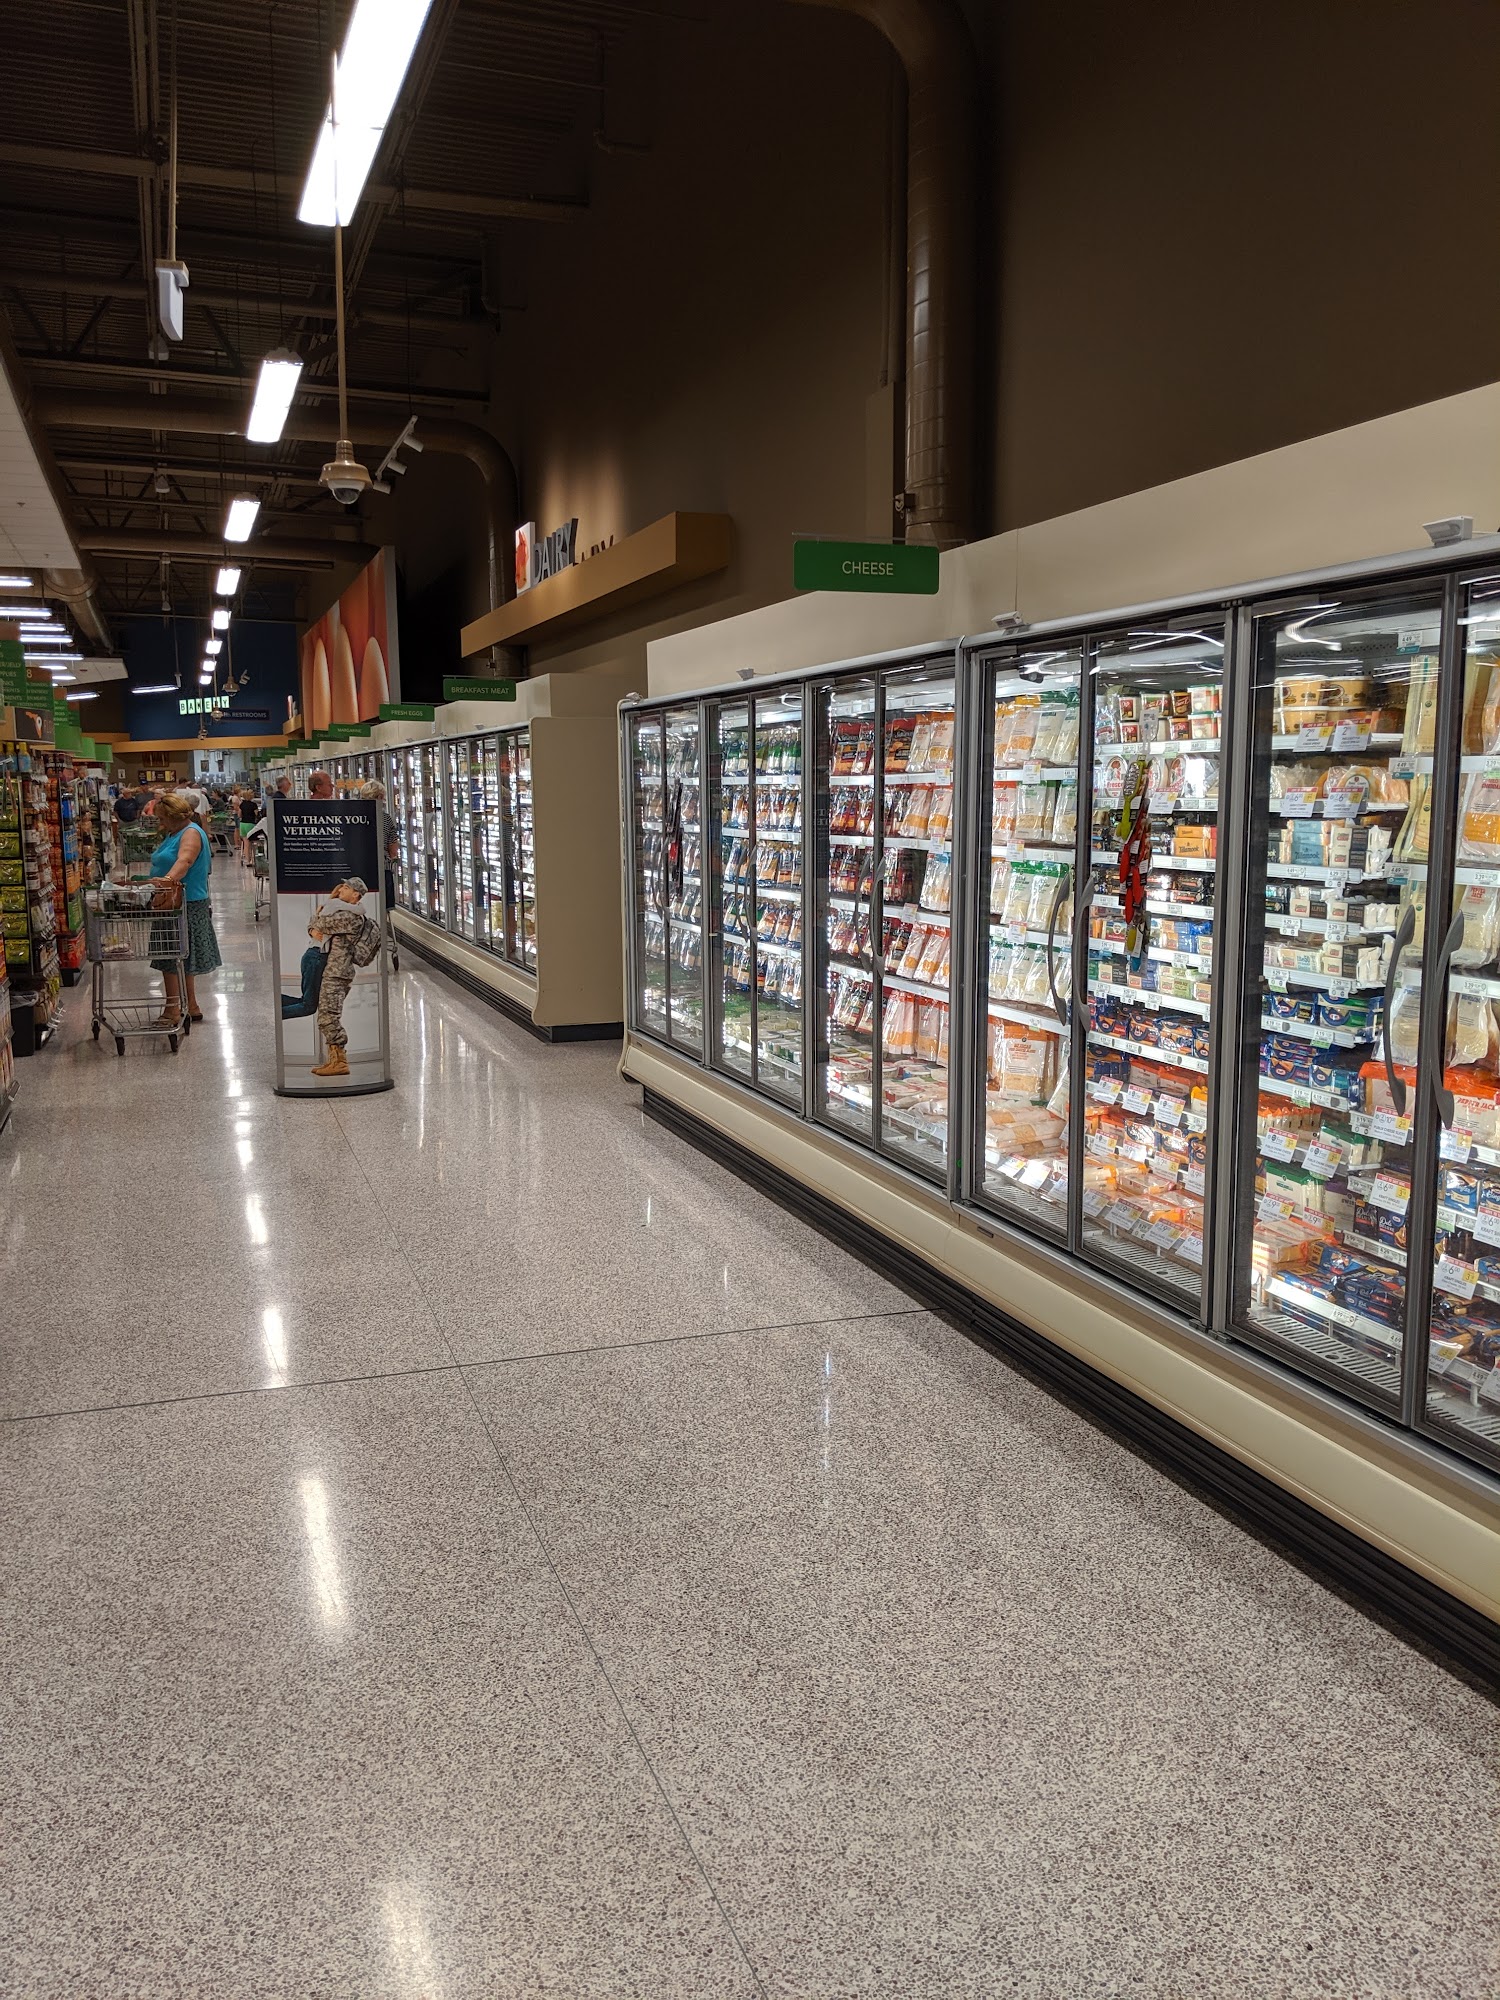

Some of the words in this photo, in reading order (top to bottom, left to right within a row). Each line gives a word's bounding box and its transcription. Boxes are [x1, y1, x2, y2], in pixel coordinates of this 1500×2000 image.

[533, 518, 578, 587] DAIRY
[842, 560, 894, 576] CHEESE
[26, 669, 32, 678] 8
[282, 816, 299, 824] WE
[301, 816, 343, 824] THANK
[344, 816, 370, 825] YOU,
[283, 827, 344, 835] VETERANS.
[1294, 851, 1319, 860] Tillamook
[1380, 1216, 1392, 1226] Deli
